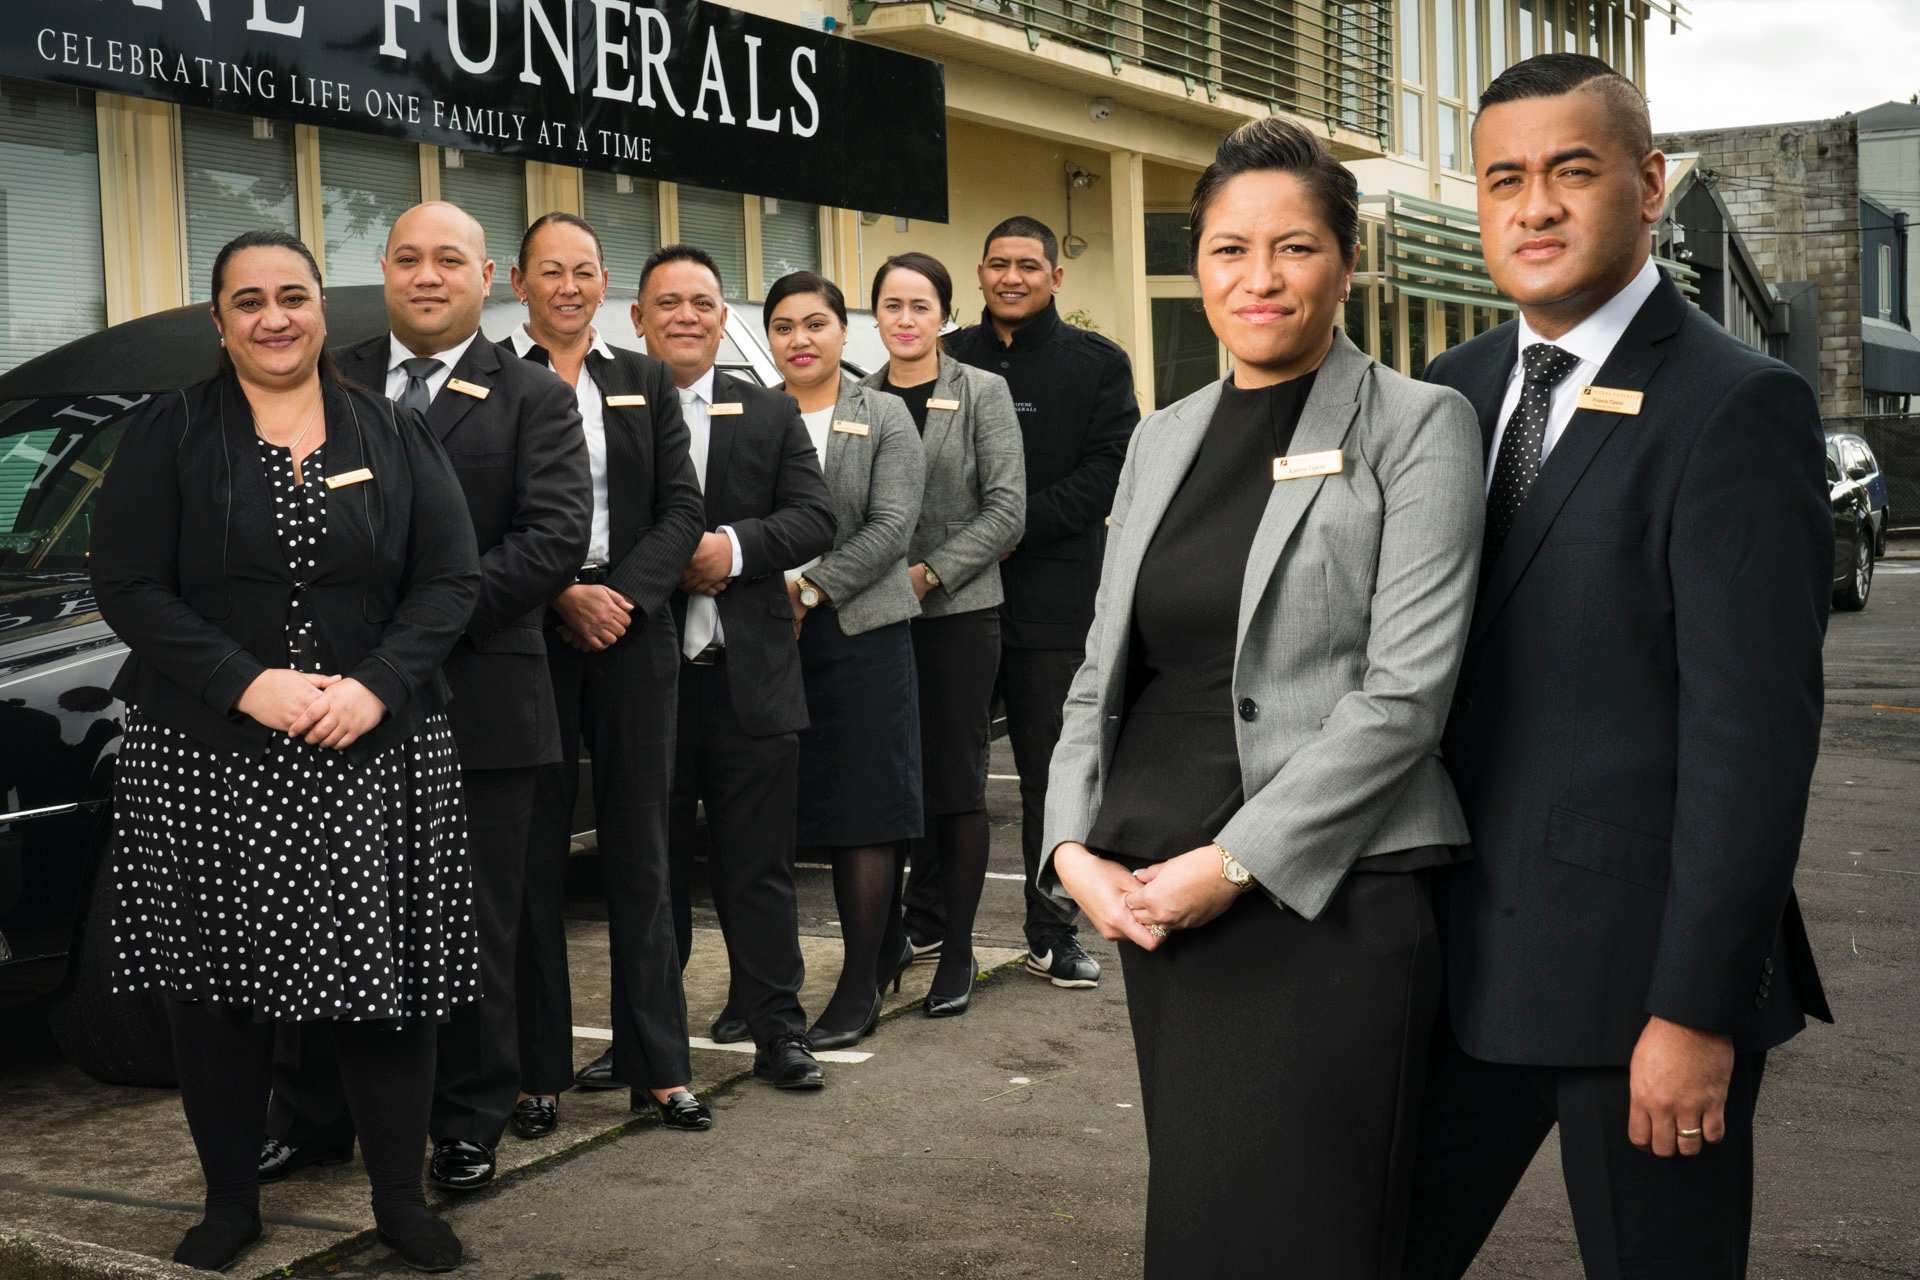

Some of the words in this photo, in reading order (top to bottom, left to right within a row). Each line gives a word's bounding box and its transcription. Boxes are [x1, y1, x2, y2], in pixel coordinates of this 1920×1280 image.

[37, 28, 275, 99] CELEBRATING
[291, 74, 351, 112] LIFE
[365, 89, 421, 124] ONE
[433, 100, 526, 142] FAMILY
[537, 120, 567, 149] AT
[576, 127, 589, 152] A
[598, 129, 653, 164] TIME
[379, 0, 820, 138] FUNERALS
